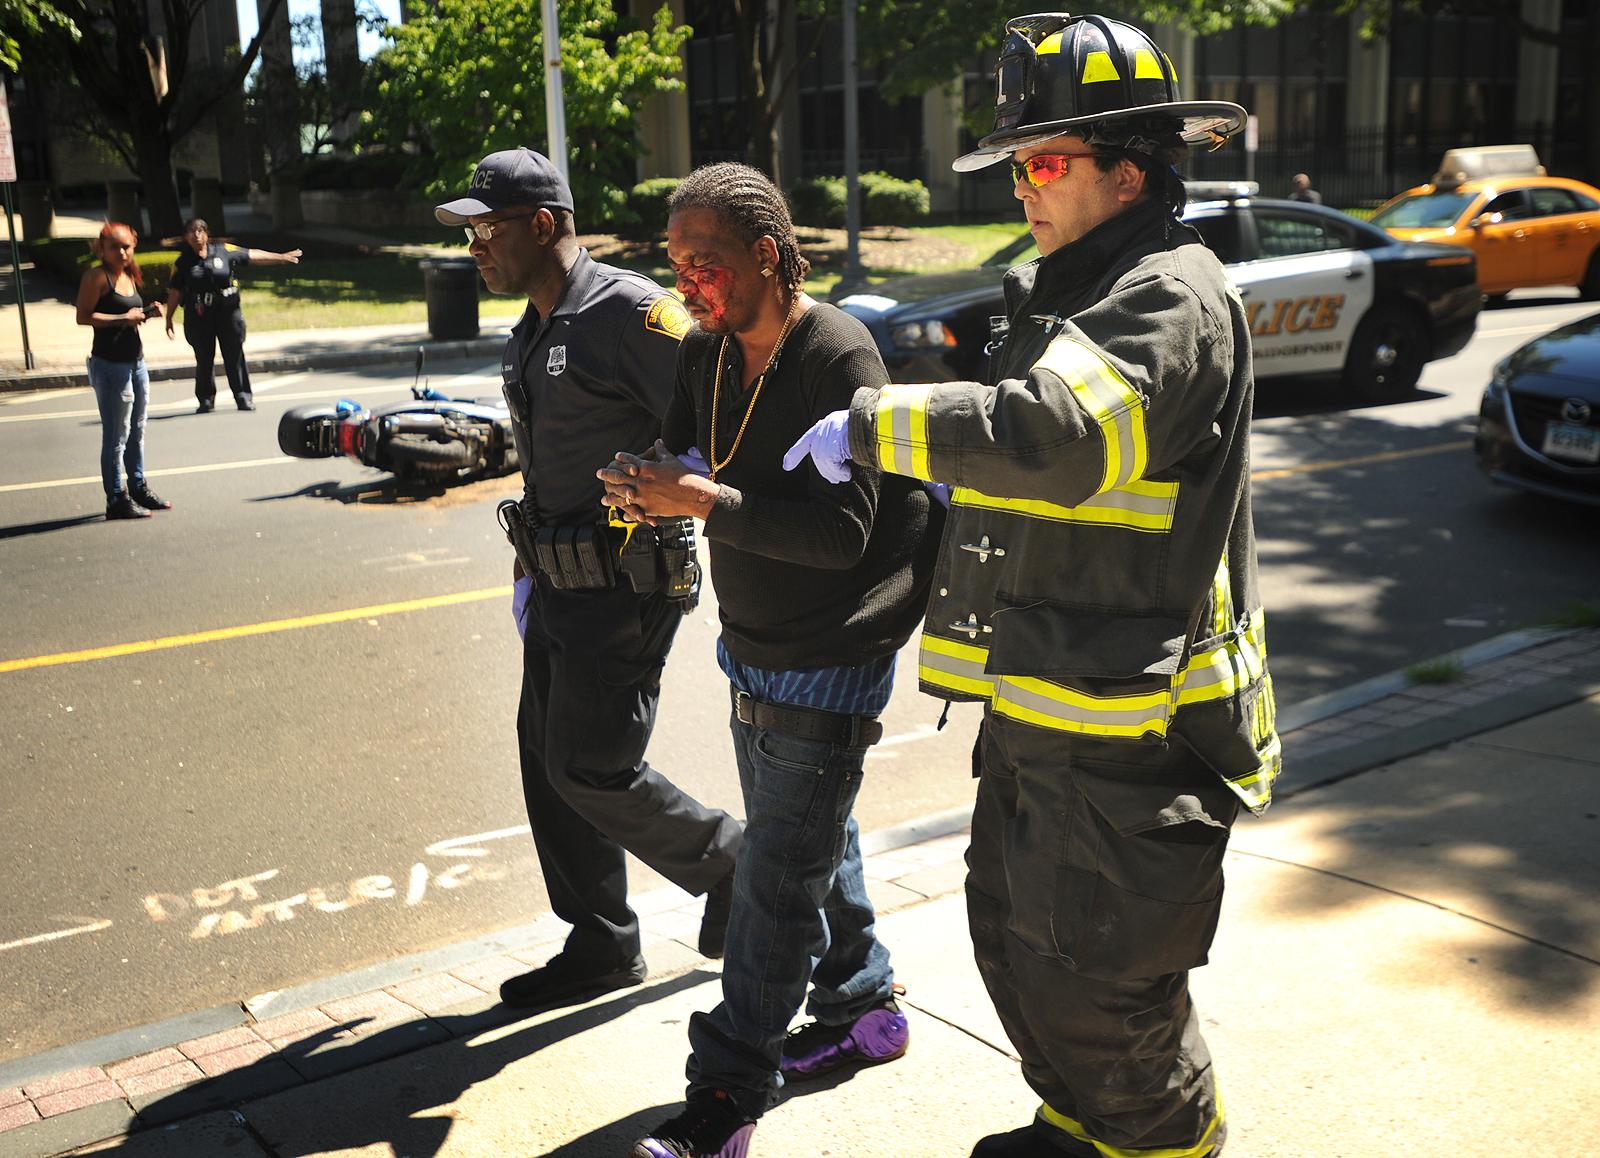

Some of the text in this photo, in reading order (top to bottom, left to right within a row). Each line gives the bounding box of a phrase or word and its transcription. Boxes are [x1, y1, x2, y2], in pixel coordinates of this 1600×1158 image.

[469, 168, 496, 190] ICE
[1247, 294, 1346, 335] LICE
[1253, 341, 1343, 358] RIDGEPORT
